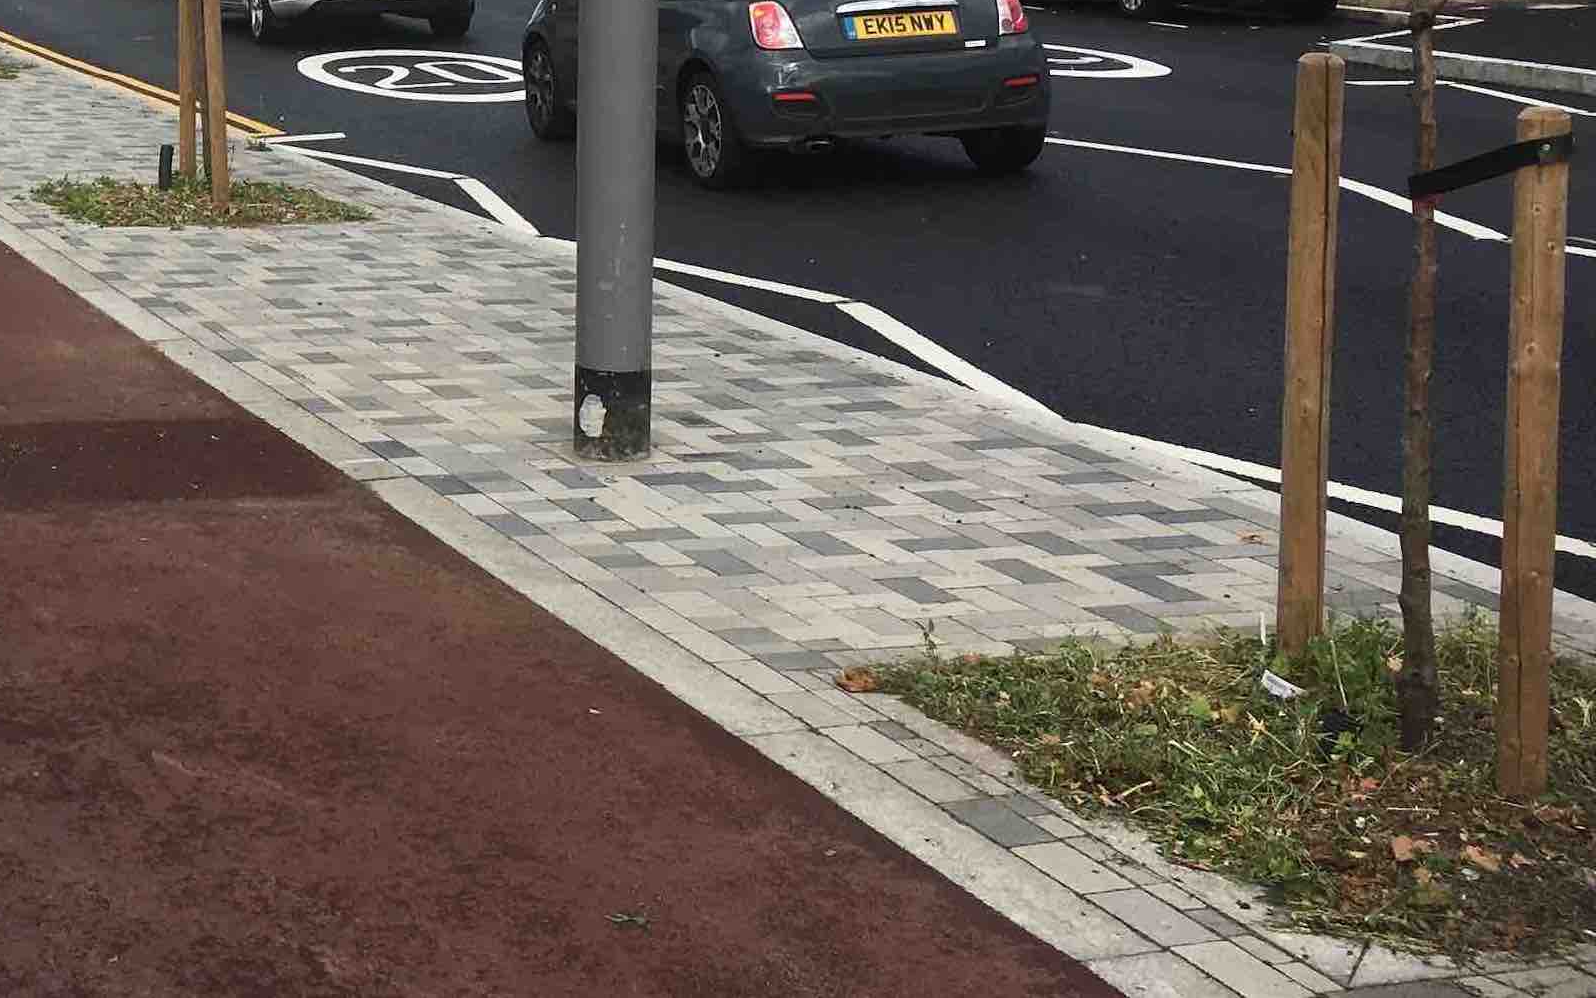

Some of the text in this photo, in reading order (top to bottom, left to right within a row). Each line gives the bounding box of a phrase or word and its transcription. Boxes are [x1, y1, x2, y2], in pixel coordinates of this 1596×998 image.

[863, 14, 945, 35] EK15 NWY
[338, 61, 525, 90] 20
